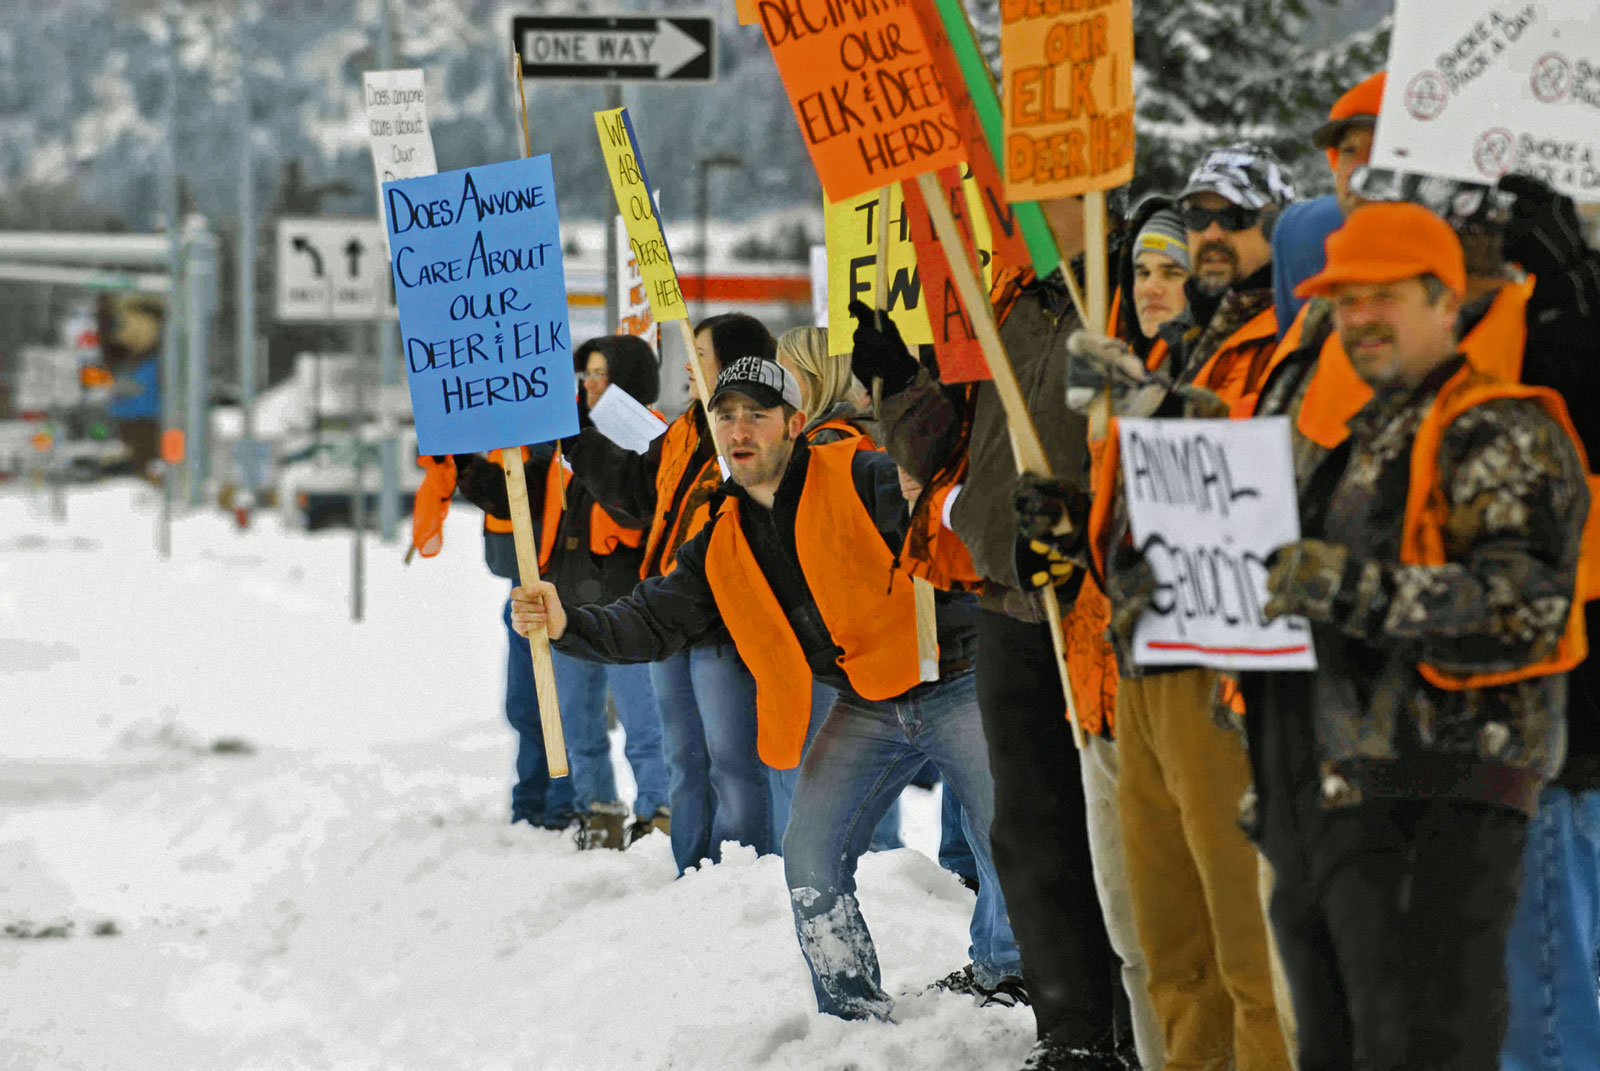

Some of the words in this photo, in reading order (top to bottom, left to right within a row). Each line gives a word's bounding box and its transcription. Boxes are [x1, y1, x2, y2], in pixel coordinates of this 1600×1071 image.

[534, 35, 587, 62] ONE
[597, 36, 657, 62] WAY
[839, 23, 921, 72] OUR
[1045, 13, 1108, 66] OUR
[798, 80, 865, 145] ELK
[1012, 63, 1099, 128] ELK
[858, 113, 962, 175] HERDS
[1008, 129, 1088, 186] DEER
[388, 187, 454, 235] DOES
[455, 172, 546, 223] ANYONE
[396, 246, 463, 288] CARE
[466, 230, 552, 279] ABOUT
[631, 238, 664, 266] DEER
[450, 287, 532, 321] OUR
[407, 333, 489, 373] DEER
[513, 320, 566, 359] ELK
[718, 363, 760, 380] NORTH
[736, 356, 761, 365] THE
[442, 366, 549, 415] HERDS
[722, 370, 759, 386] FACE
